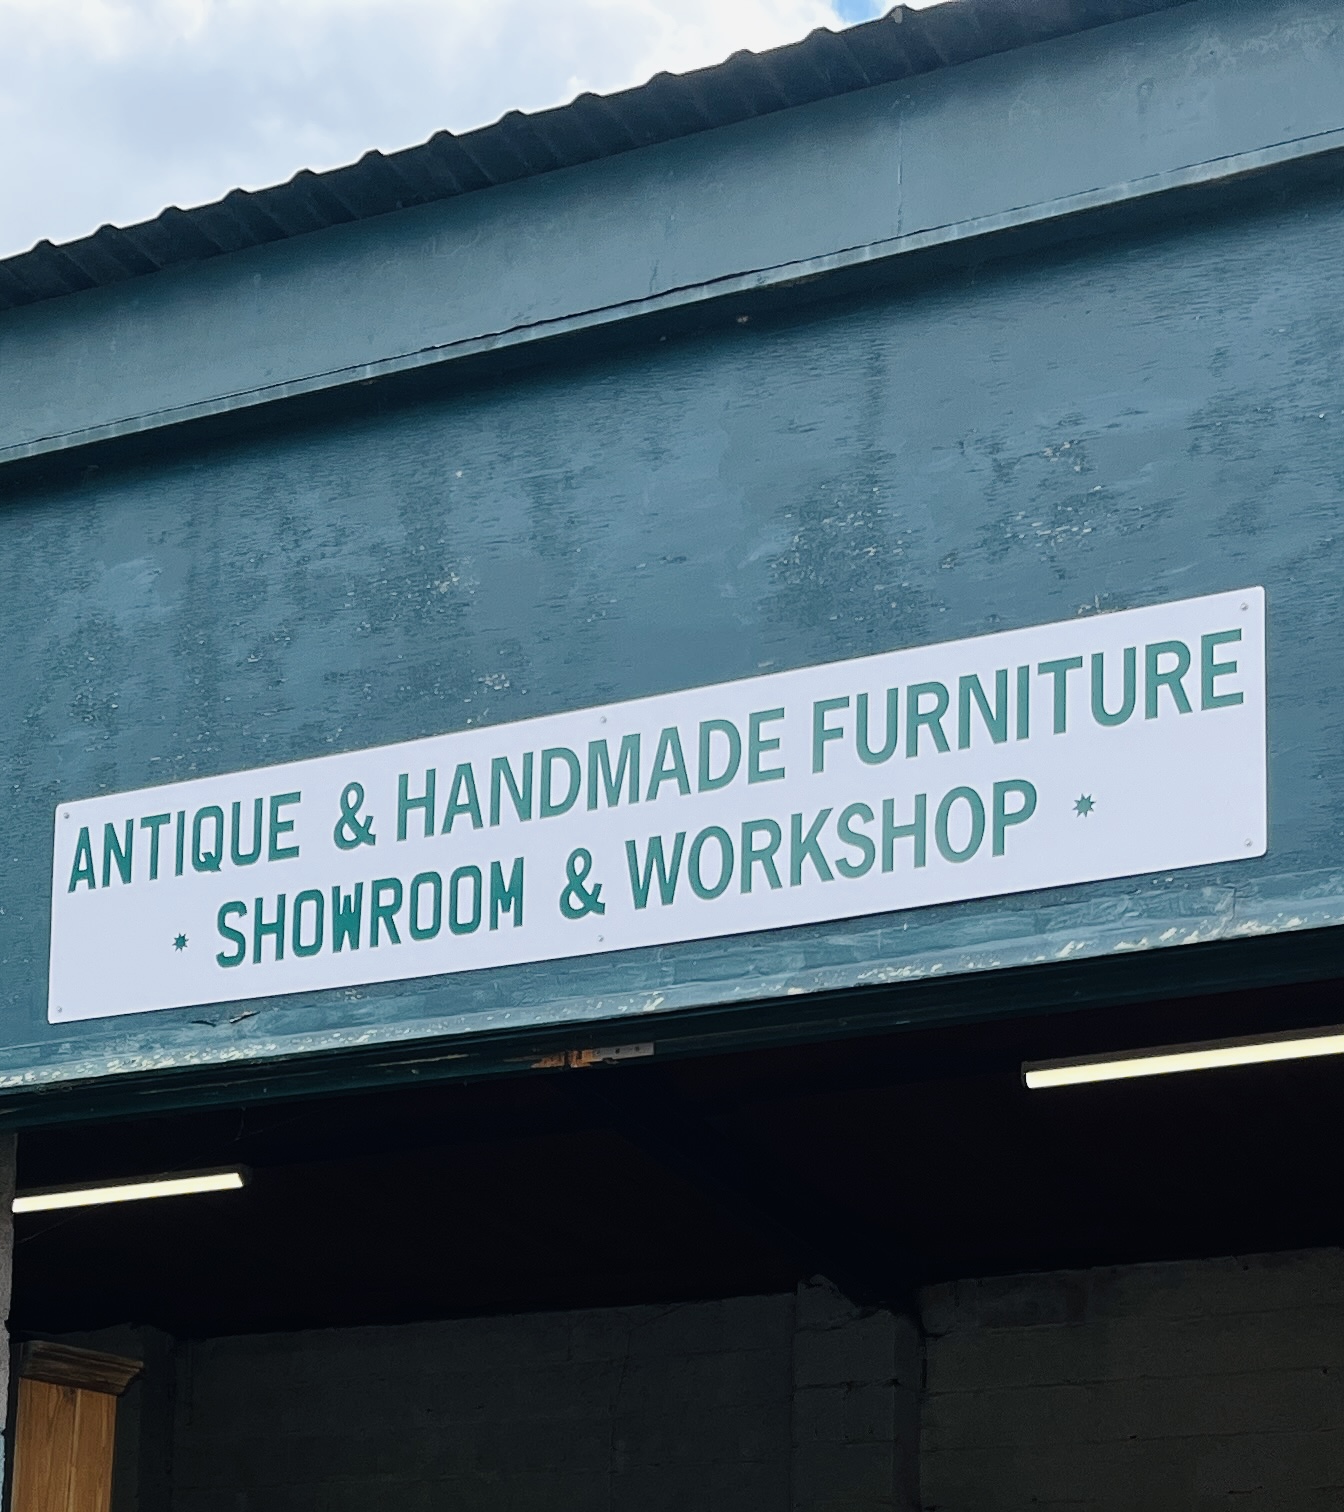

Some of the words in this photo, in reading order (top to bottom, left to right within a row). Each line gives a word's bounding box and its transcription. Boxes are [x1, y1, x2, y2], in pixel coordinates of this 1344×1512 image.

[68, 791, 301, 893] ANTIQUE
[334, 782, 377, 850] &
[397, 708, 786, 841] HANDMADE
[813, 628, 1244, 774] FURNITURE
[216, 857, 525, 968] SHOWROOM
[560, 848, 606, 920] &
[625, 779, 1038, 910] WORKSHOP
